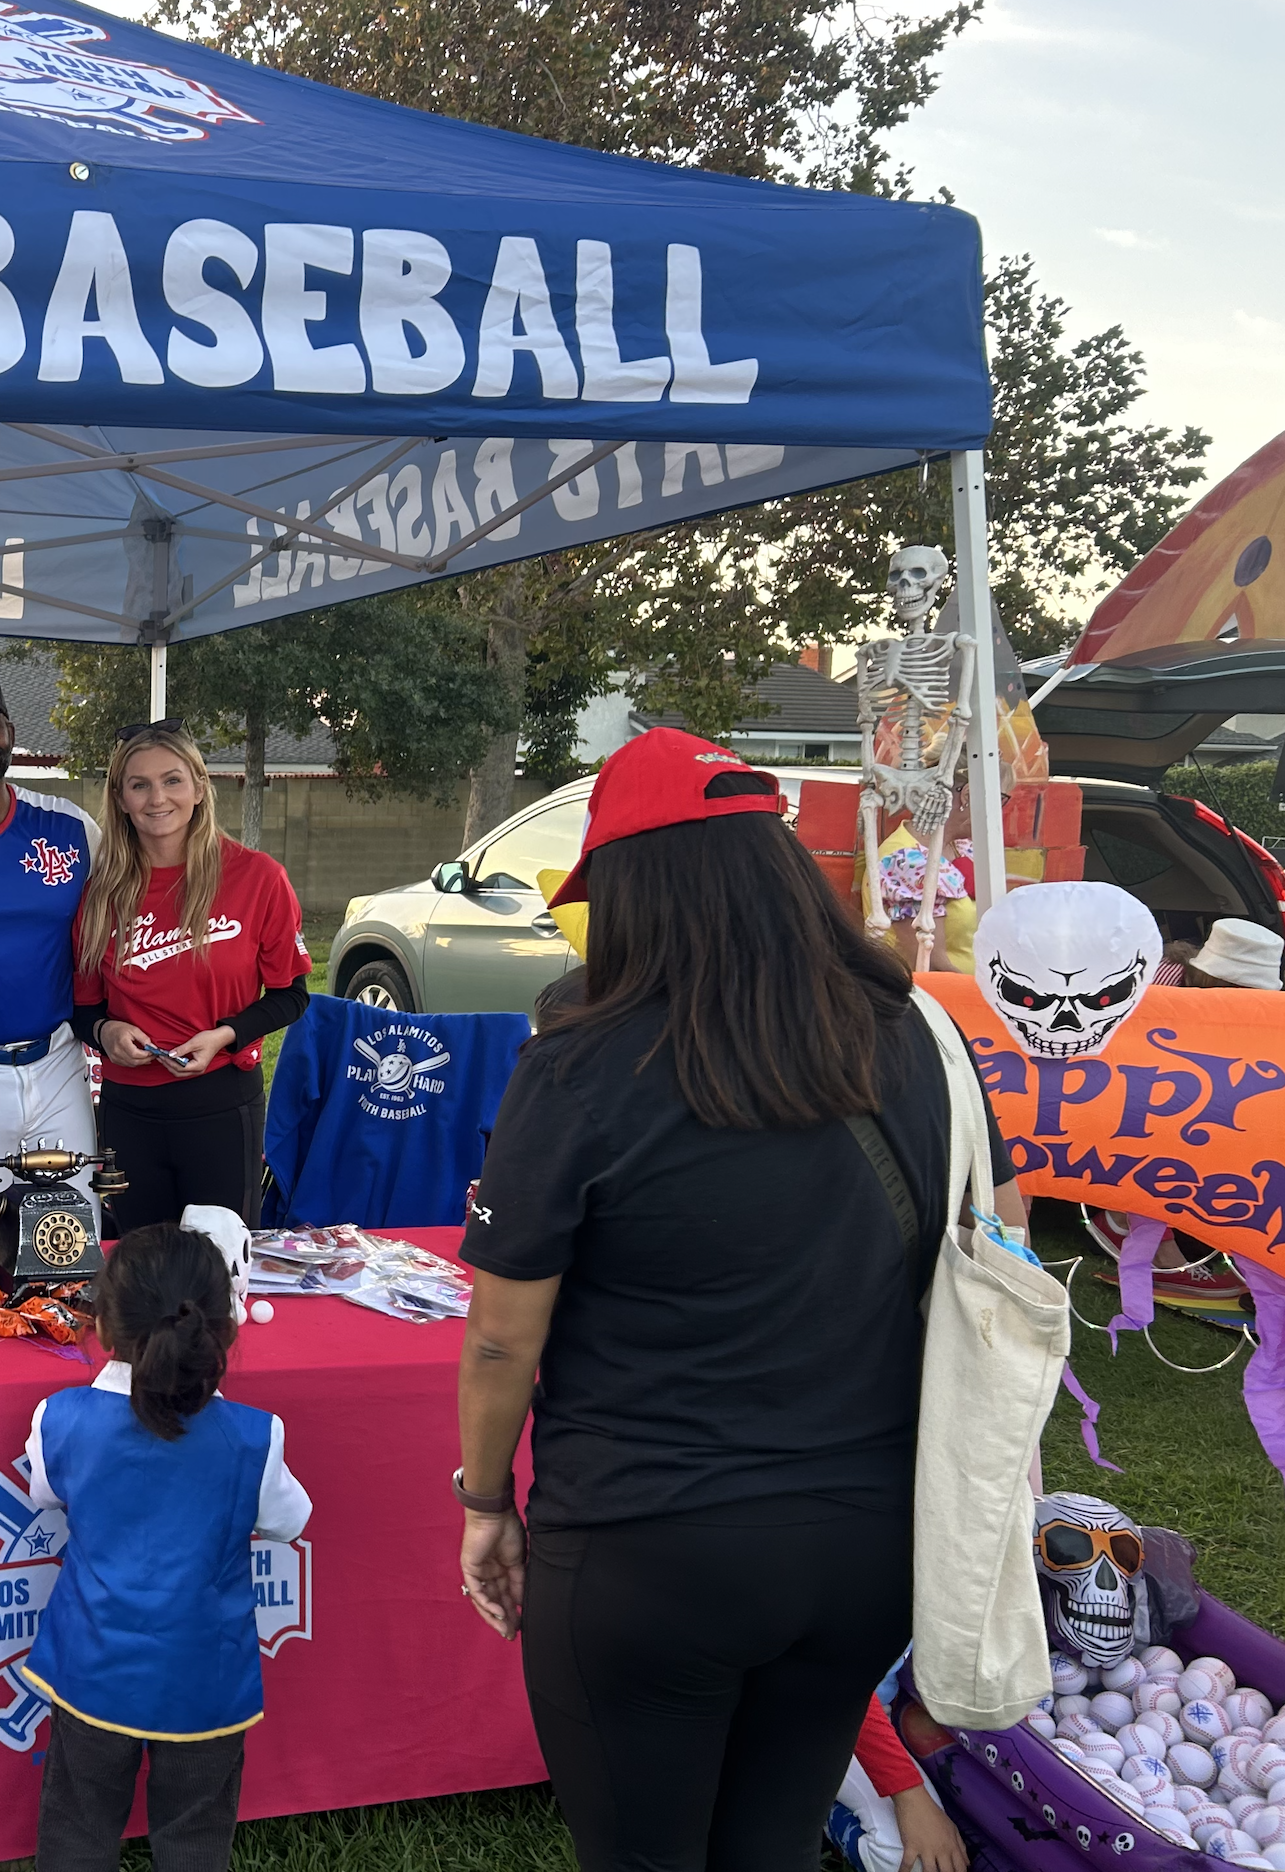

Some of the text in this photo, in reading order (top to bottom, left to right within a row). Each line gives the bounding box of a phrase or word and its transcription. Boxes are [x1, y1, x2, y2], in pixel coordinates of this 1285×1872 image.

[27, 47, 149, 83] YOUTH
[141, 953, 160, 964] ALL
[367, 1024, 443, 1053] LOS ALAMITOS
[413, 1074, 445, 1094] HARD
